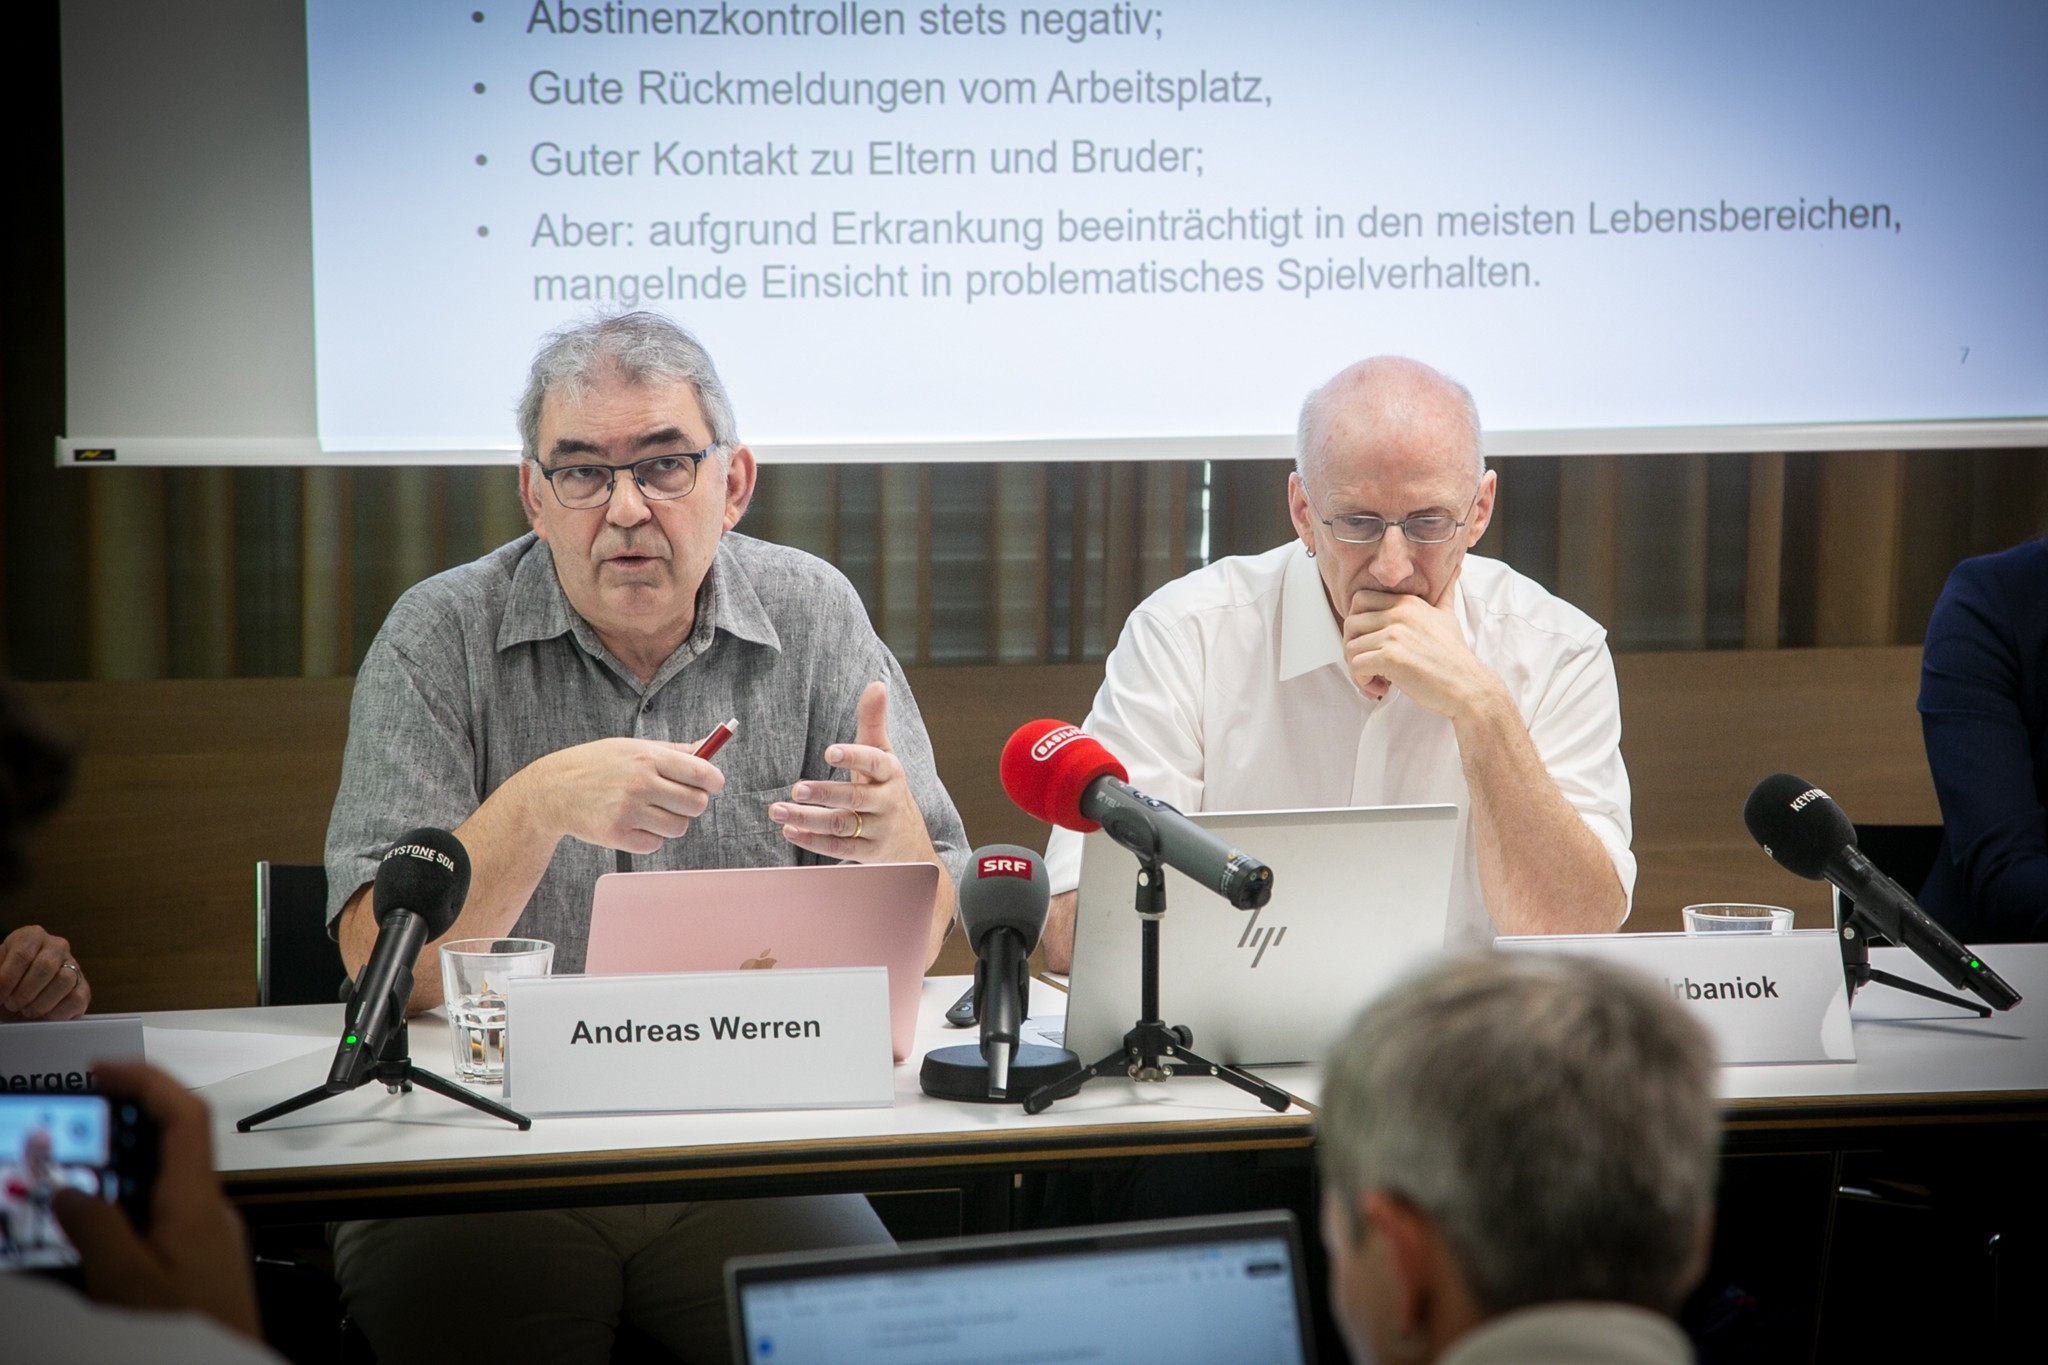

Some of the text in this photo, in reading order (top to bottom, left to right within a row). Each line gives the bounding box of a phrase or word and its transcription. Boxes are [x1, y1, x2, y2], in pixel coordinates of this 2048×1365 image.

[526, 0, 1162, 43] Abstinenzkontrollen stets negativ;
[529, 69, 1271, 113] Gute Rückmeldungen vom Arbeitsplatz,
[531, 139, 1203, 176] Guter Kontakt zu Eltern und Bruder;
[531, 197, 1901, 254] Aber: aufgrund Erkrankung beeinträchtigt in den meisten Lebensbereichen,
[534, 255, 1540, 306] mangelnde Einsicht in problematisches Spielverhalten.
[1960, 346, 1970, 364] 7
[436, 852, 454, 872] SDA
[984, 860, 1027, 872] SRF
[1237, 908, 1287, 968] hp
[570, 1016, 821, 1044] Andreas Werren
